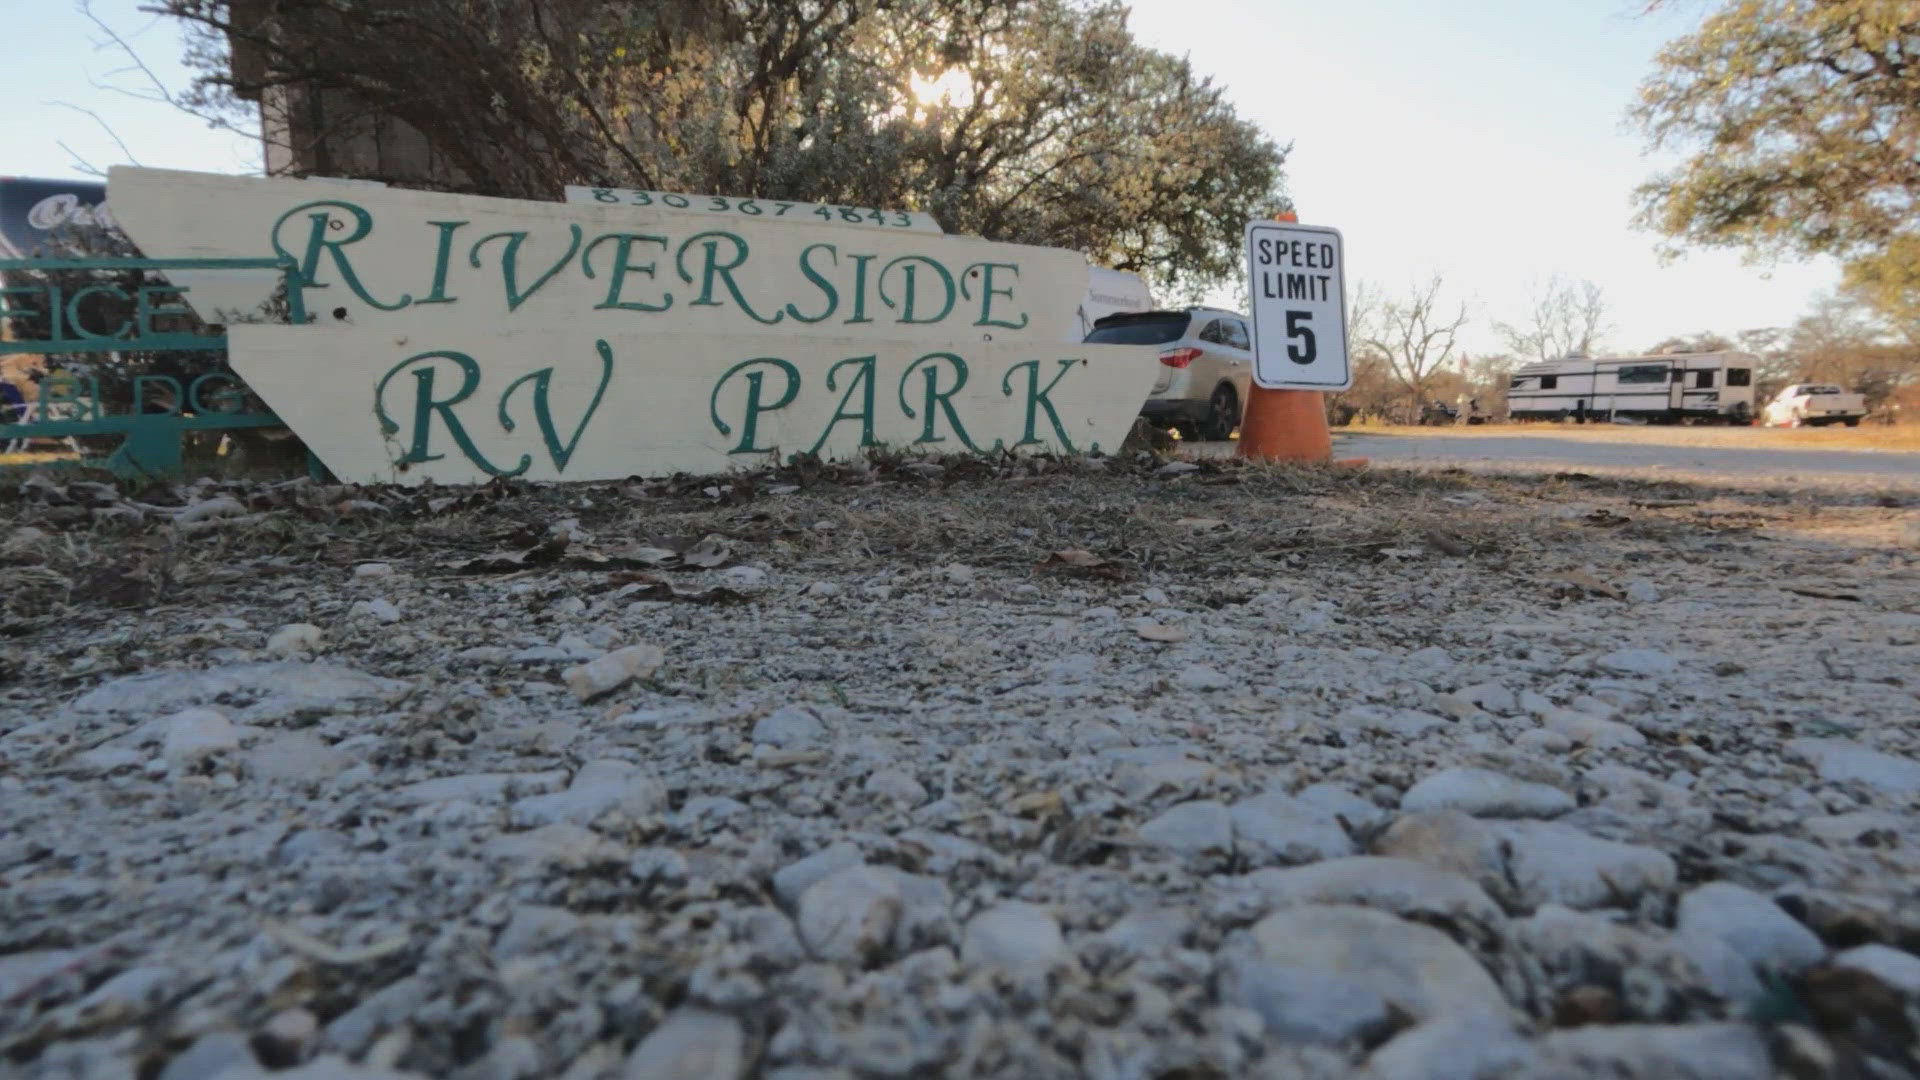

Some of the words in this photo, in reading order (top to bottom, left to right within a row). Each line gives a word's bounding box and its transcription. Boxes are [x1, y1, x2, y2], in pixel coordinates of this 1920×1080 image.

[591, 188, 690, 209] 830
[707, 196, 795, 217] 367
[271, 200, 1029, 329] RIVERSIDE
[1258, 238, 1334, 270] SPEED
[1263, 271, 1331, 302] LIMIT
[1285, 310, 1317, 365] 5
[37, 372, 247, 421] BLDG
[376, 339, 614, 477] RV
[710, 352, 1101, 465] PARK
